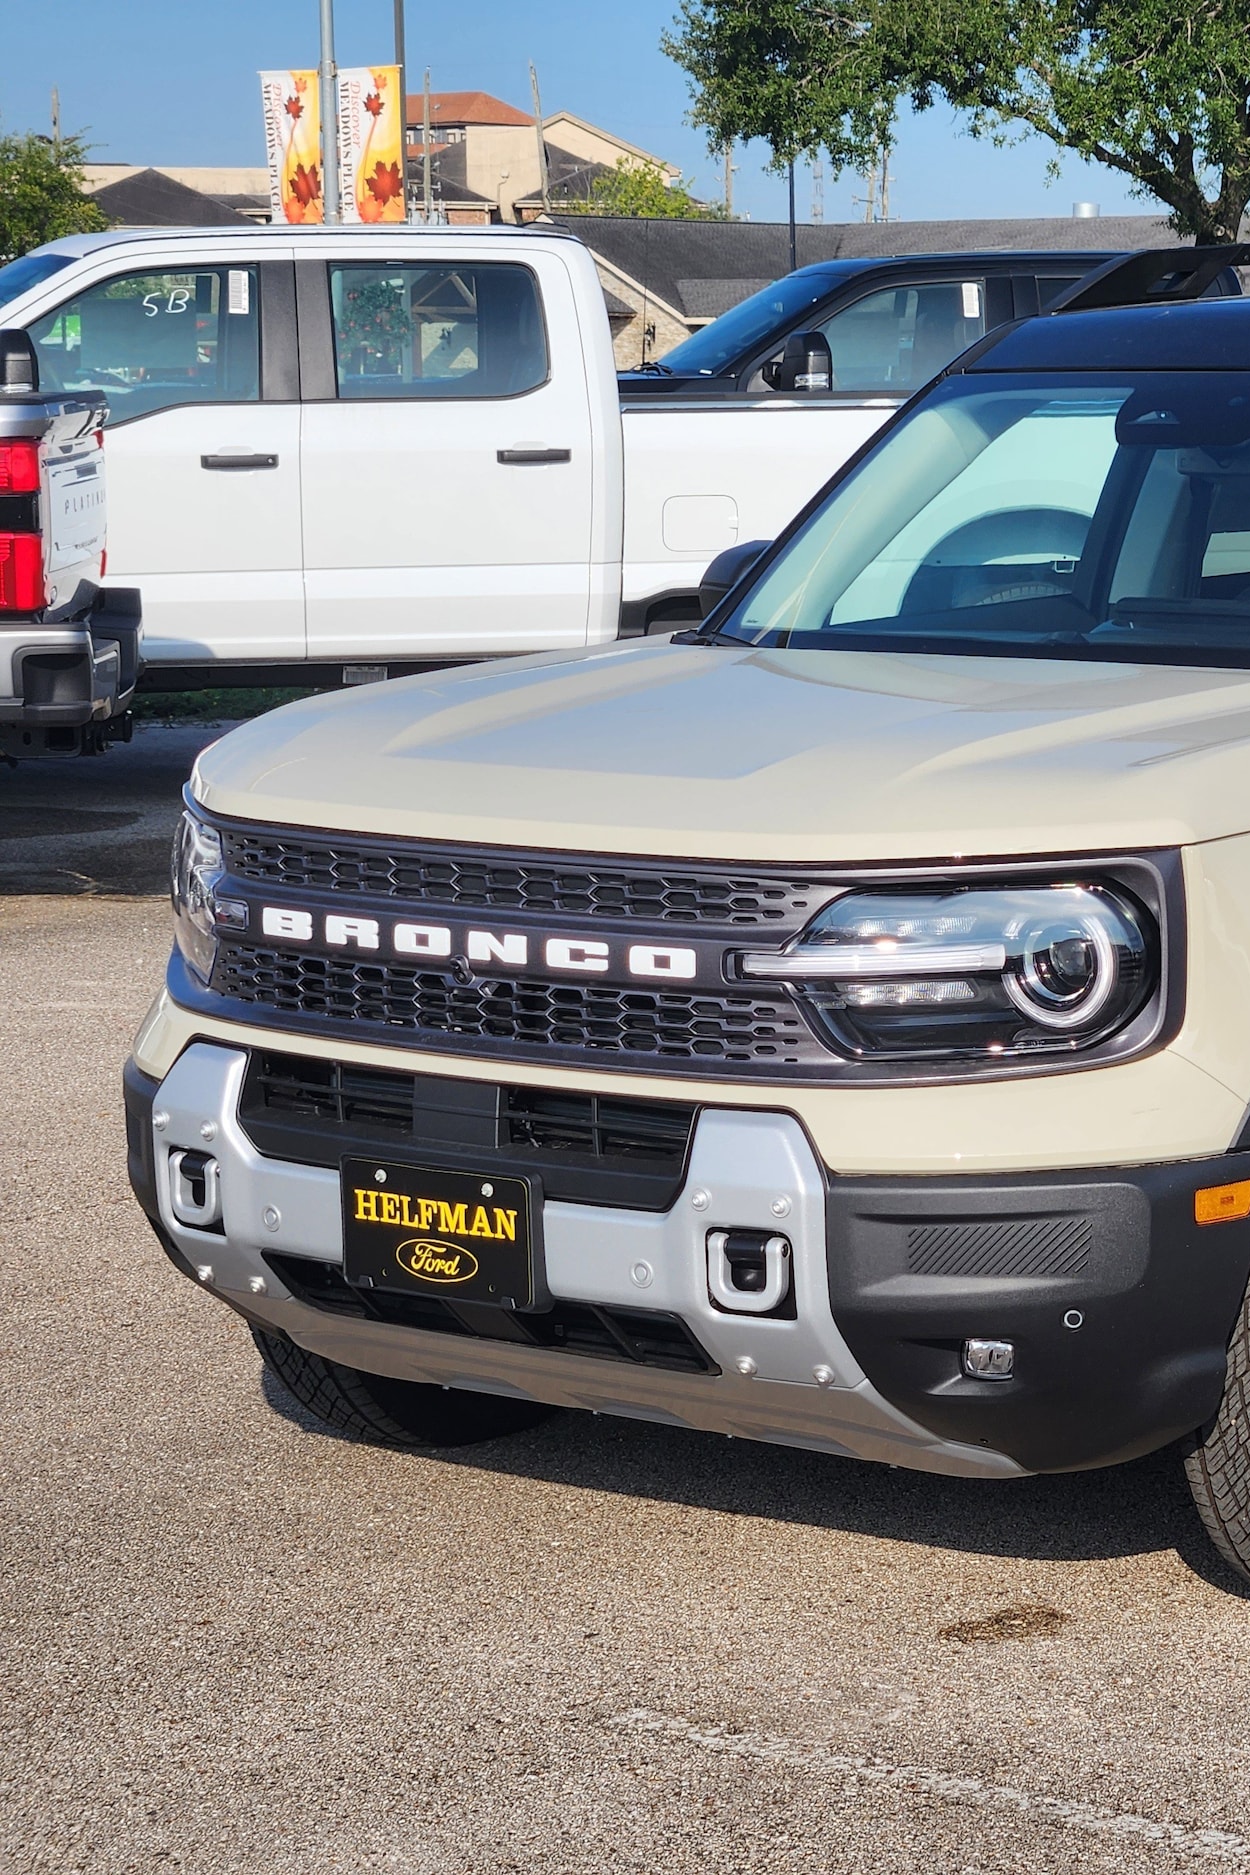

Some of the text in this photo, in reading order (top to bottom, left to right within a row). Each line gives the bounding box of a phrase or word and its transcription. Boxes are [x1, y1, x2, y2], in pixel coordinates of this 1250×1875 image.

[264, 83, 281, 212] MEADOWS PLACE
[273, 83, 283, 148] Discover
[340, 81, 354, 212] MEADOWS PLACE
[350, 81, 361, 148] Discover
[262, 906, 697, 979] BRONCO
[354, 1188, 517, 1242] HELFMAN
[411, 1243, 460, 1276] Ford
